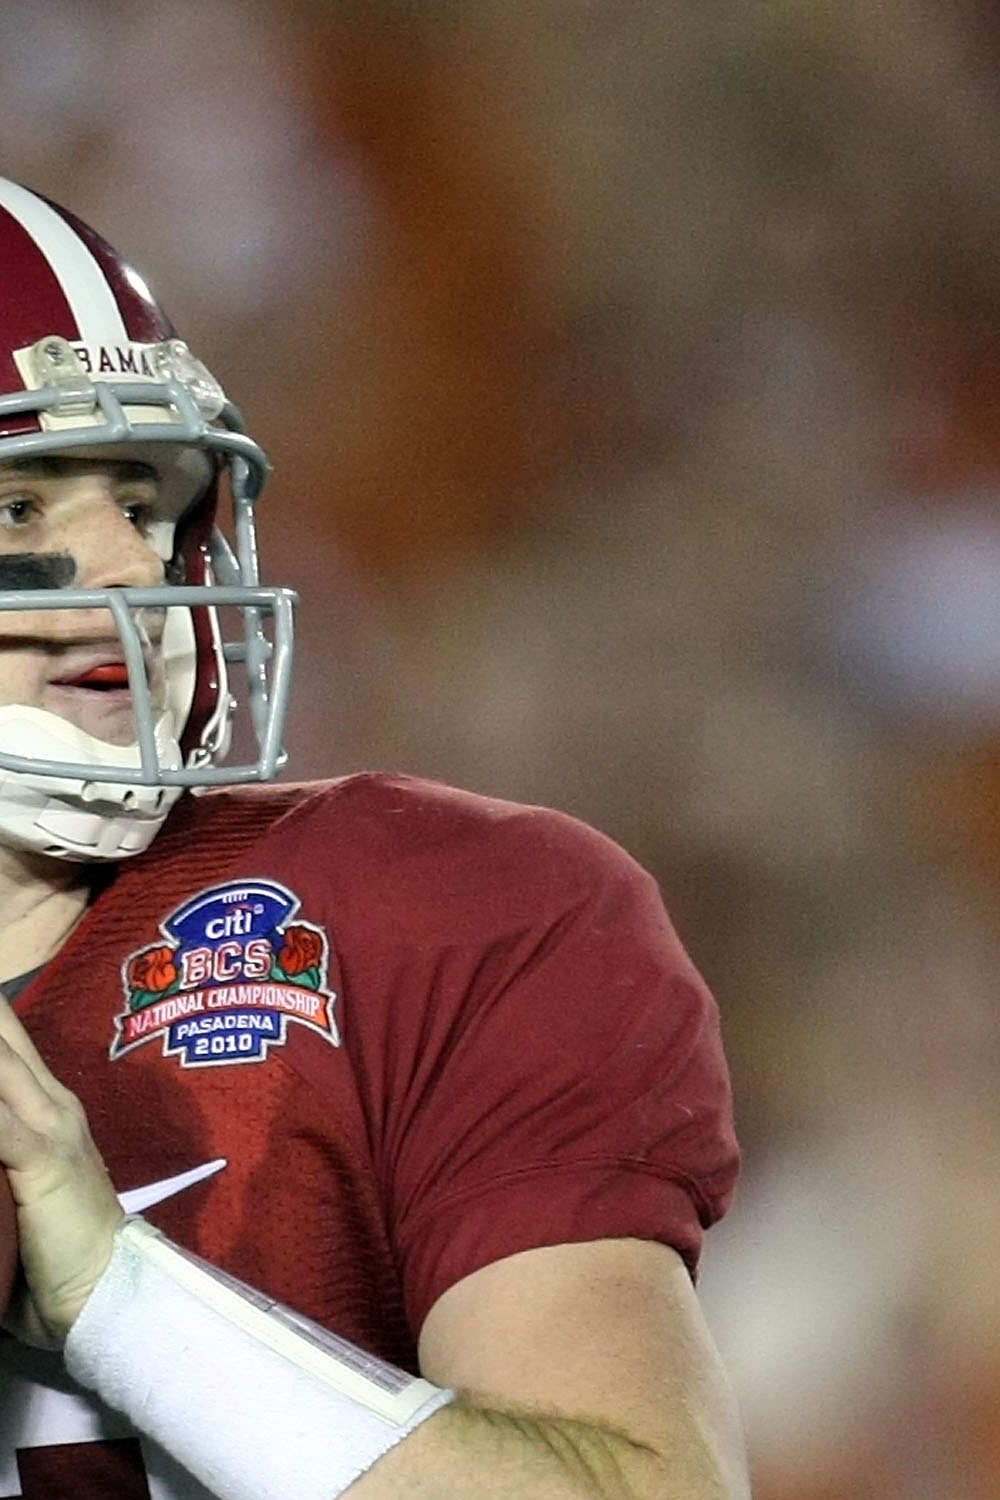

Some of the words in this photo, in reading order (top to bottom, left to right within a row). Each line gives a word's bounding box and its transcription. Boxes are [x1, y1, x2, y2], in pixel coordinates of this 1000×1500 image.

[205, 907, 252, 939] citi
[180, 938, 273, 990] BCS
[129, 993, 205, 1037] NATIONAL
[207, 982, 321, 1017] CHAMPIONSHIP
[177, 1015, 274, 1040] PASADENA
[194, 1034, 253, 1056] 2010
